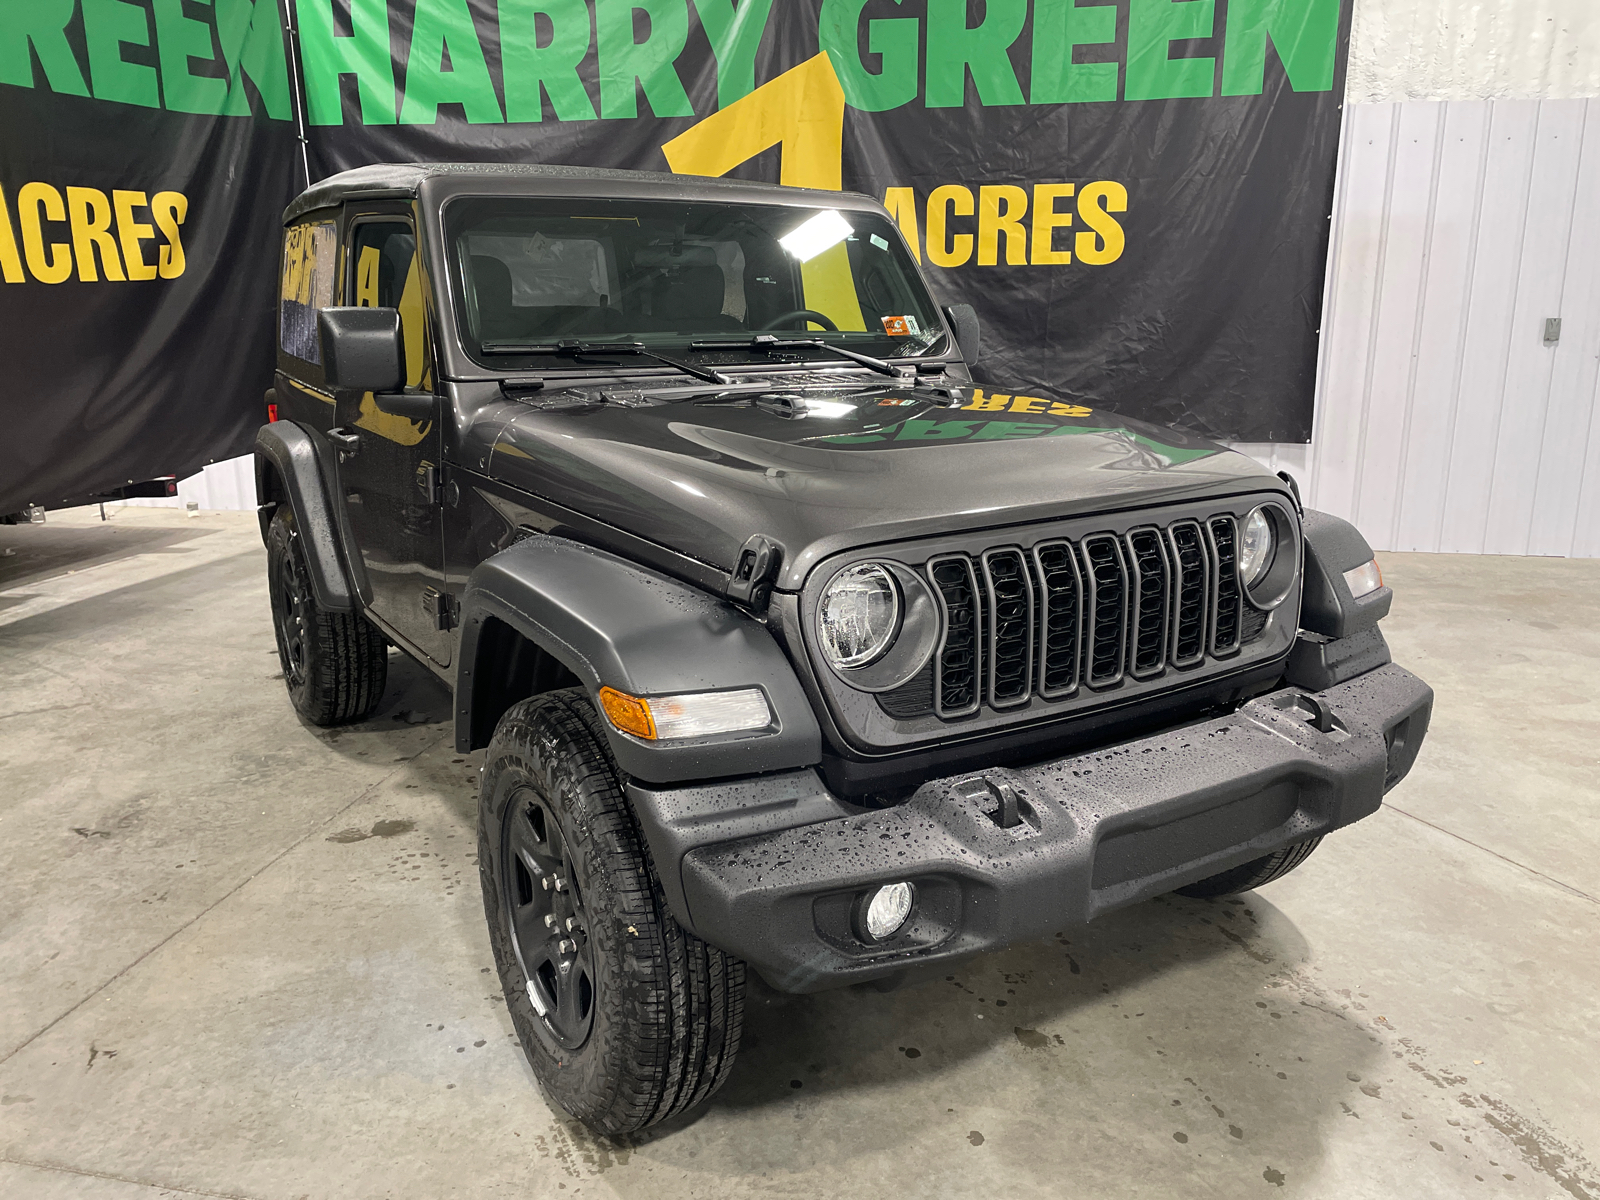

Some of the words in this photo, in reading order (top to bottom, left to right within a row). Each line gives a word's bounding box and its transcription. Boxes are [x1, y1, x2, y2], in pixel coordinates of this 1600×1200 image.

[0, 0, 293, 121] REEN
[301, 0, 772, 126] HARRY
[818, 0, 1338, 112] GREEN
